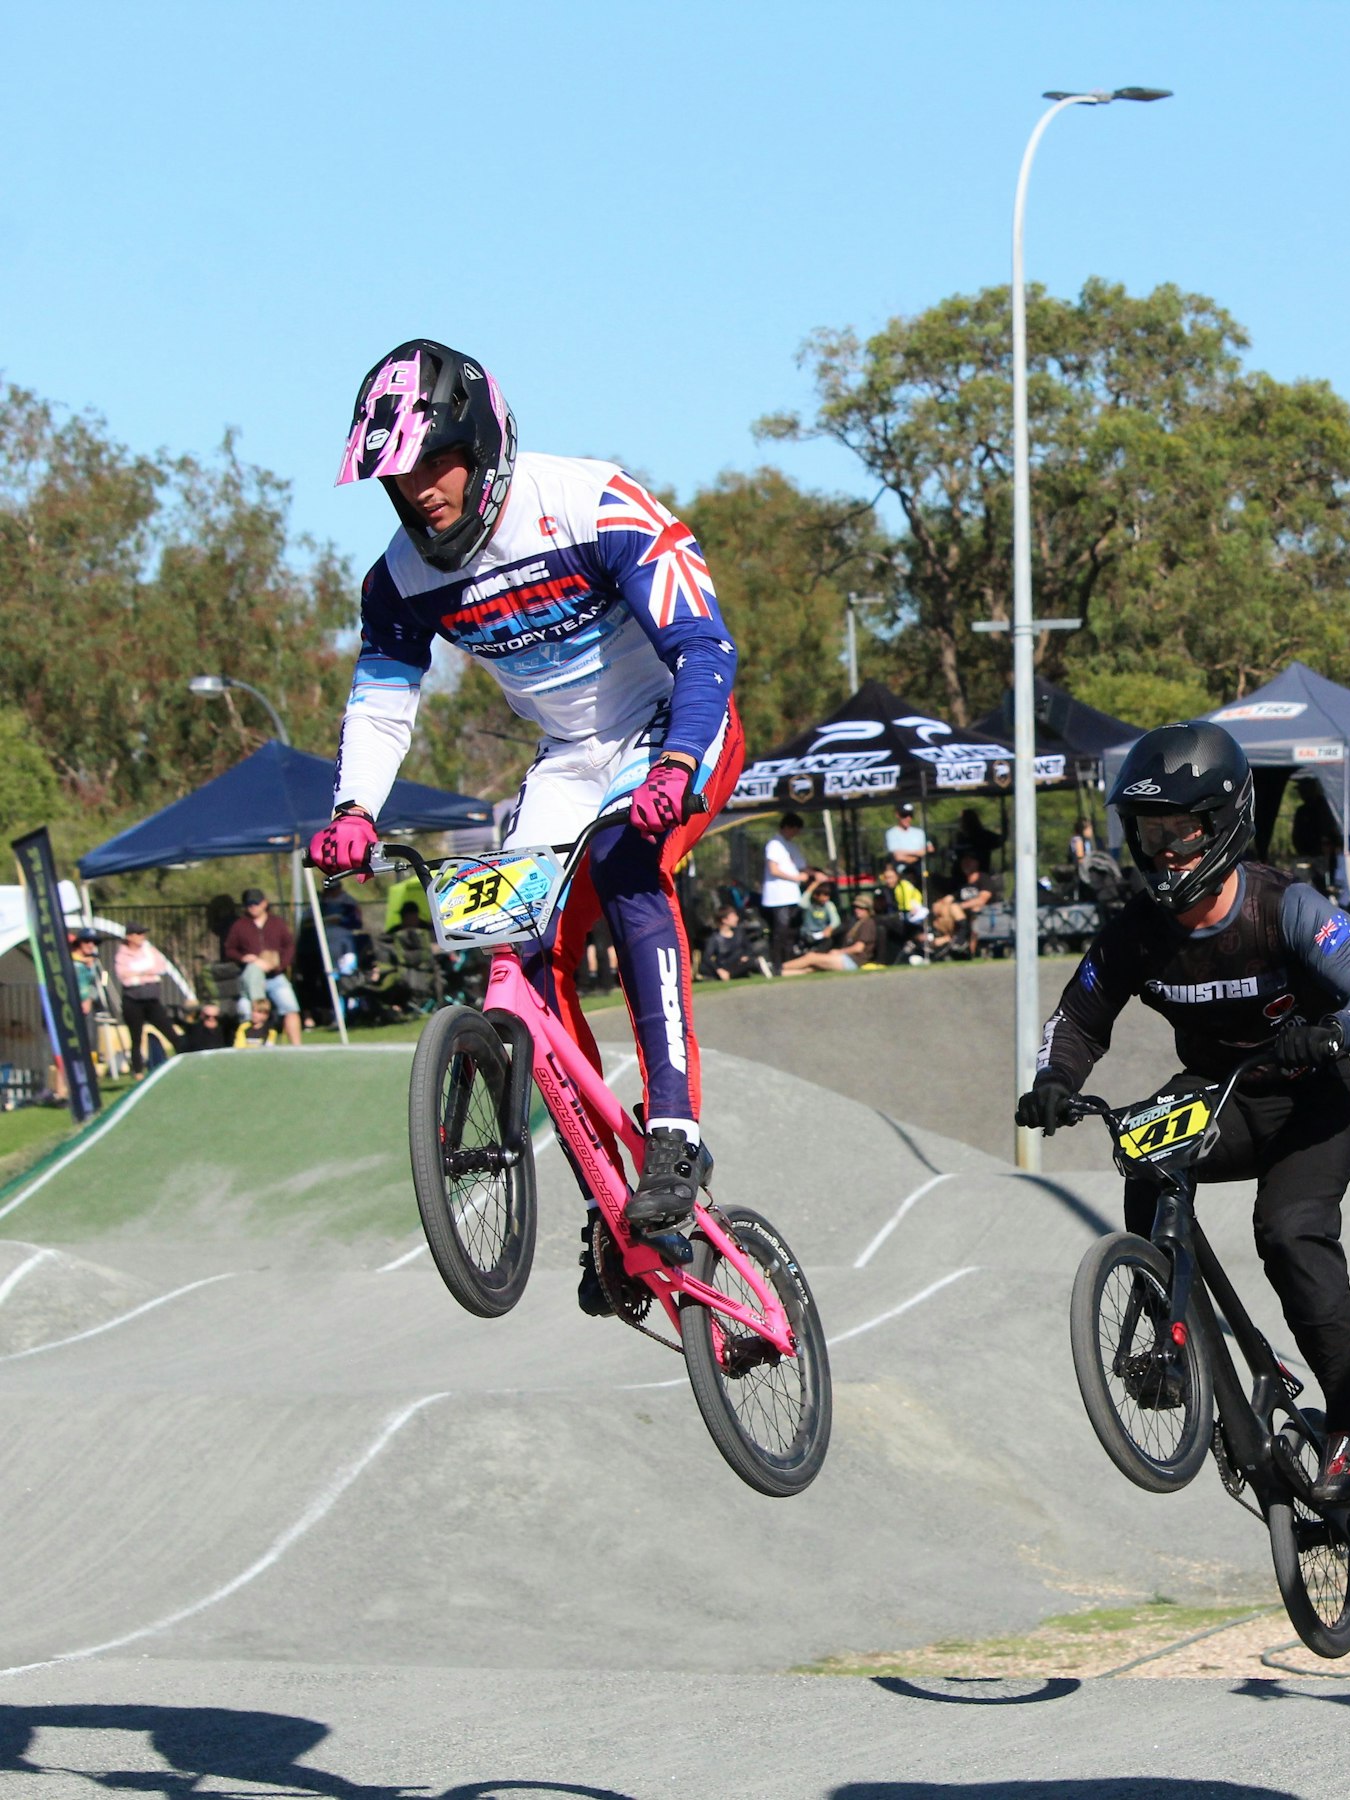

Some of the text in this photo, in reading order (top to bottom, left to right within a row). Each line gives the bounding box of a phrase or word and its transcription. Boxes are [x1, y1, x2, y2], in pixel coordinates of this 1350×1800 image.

[464, 628, 546, 654] ACTORY
[463, 874, 503, 915] 33
[1157, 1094, 1175, 1105] box
[1137, 1108, 1194, 1149] 41
